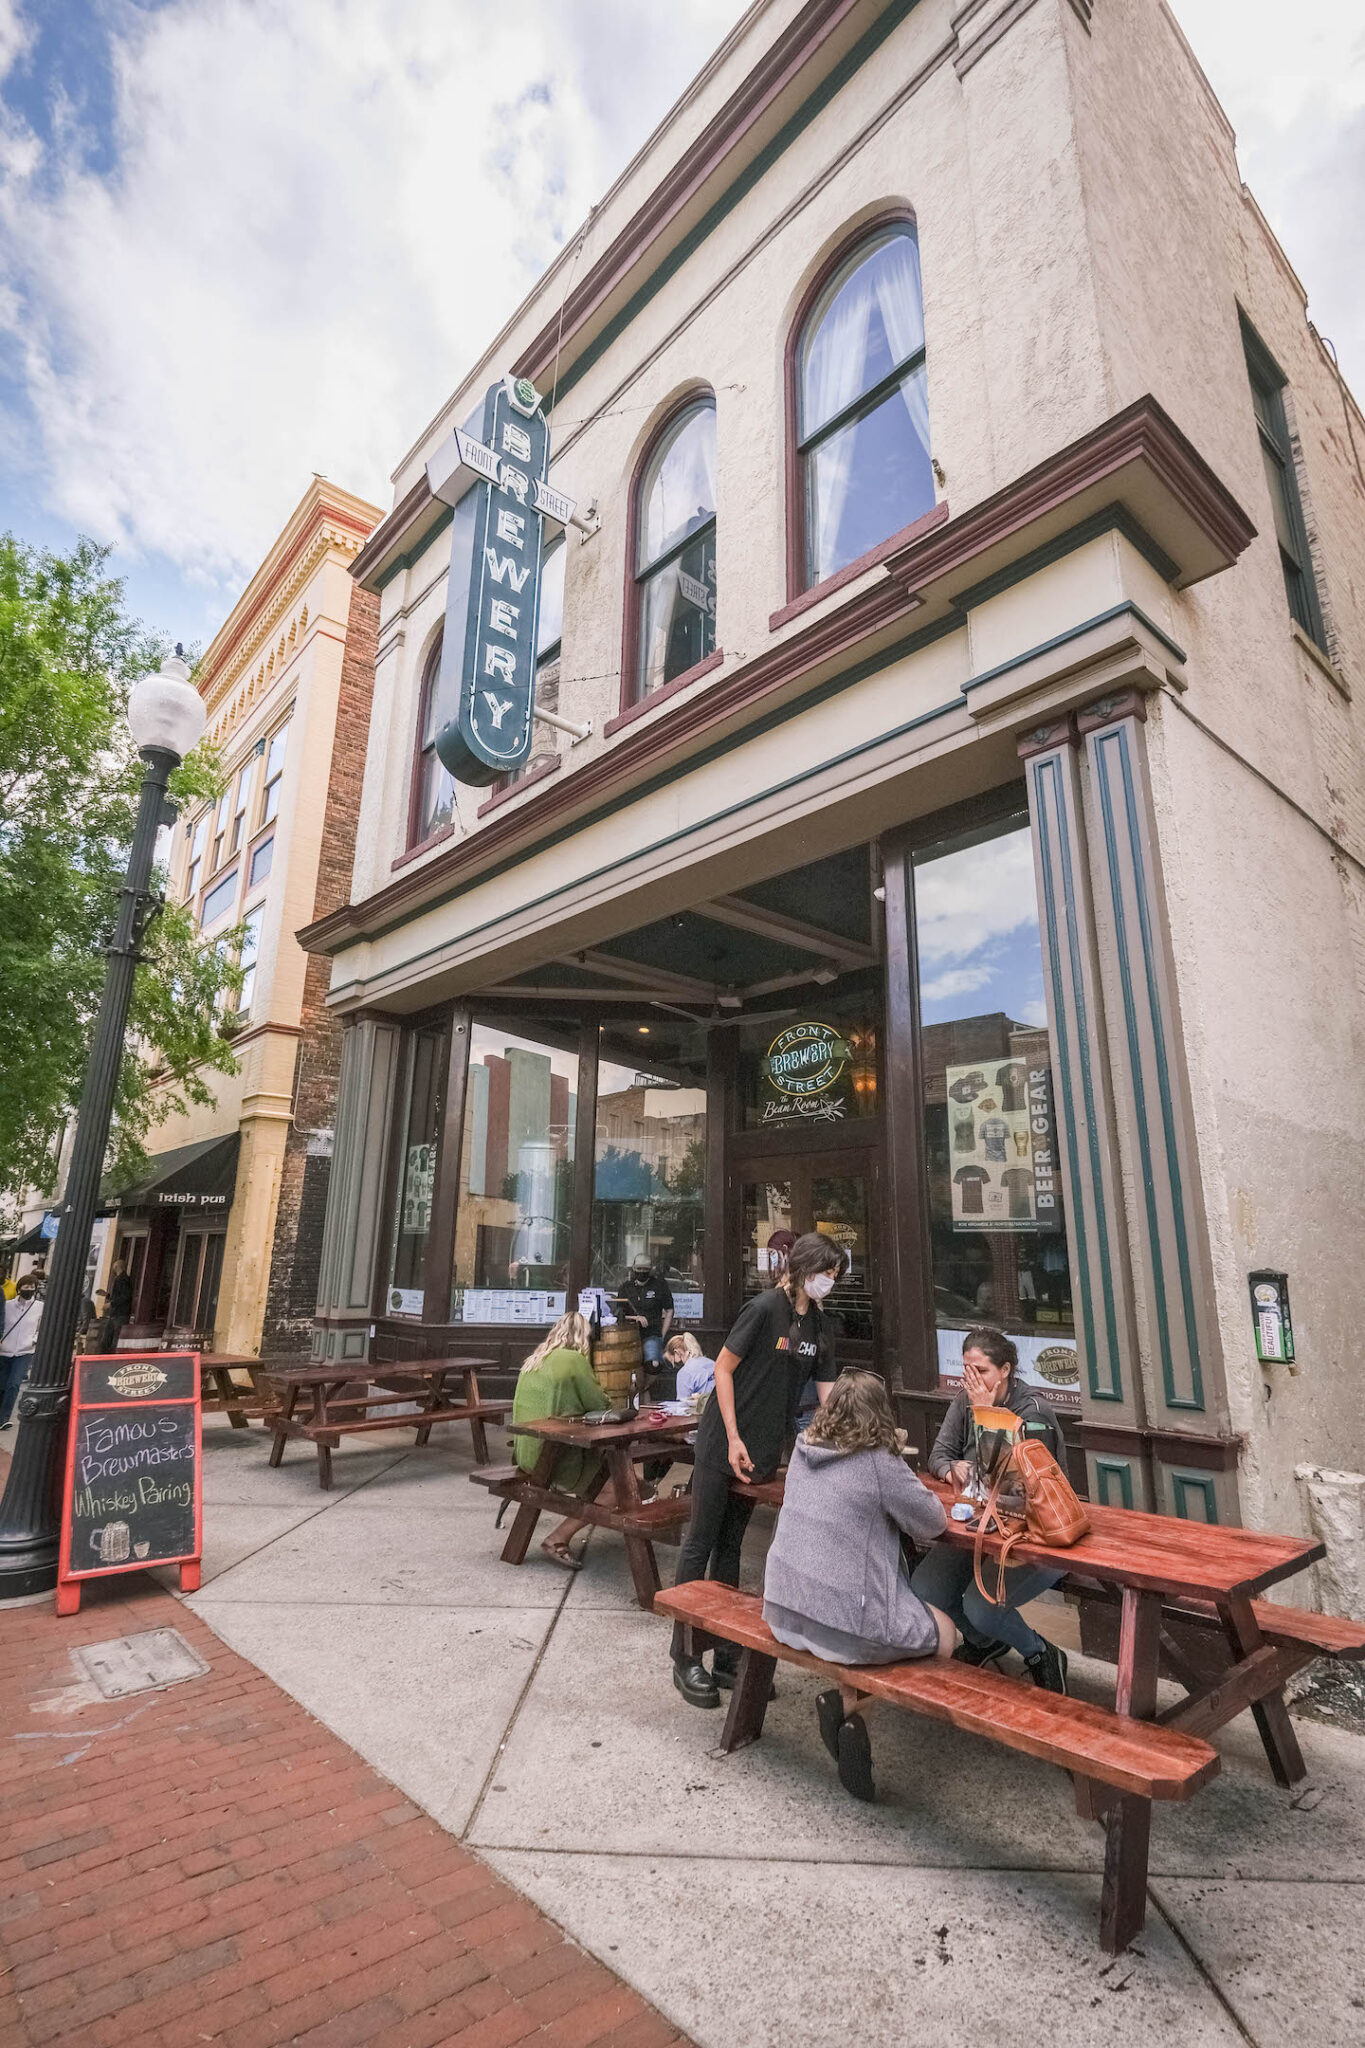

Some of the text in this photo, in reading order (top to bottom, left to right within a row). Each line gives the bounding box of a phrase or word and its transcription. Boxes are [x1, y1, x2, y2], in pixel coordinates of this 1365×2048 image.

[465, 441, 493, 472] FRONT
[540, 488, 569, 519] STREET
[482, 422, 532, 730] BREWERY
[777, 1025, 832, 1049] FRONT
[773, 1040, 834, 1075] BREWERY
[776, 1066, 834, 1092] STREET
[791, 1097, 820, 1113] Room
[1029, 1068, 1055, 1208] BEER GEAR
[1041, 1348, 1078, 1359] FRONT
[116, 1372, 158, 1387] BREWERY
[119, 1364, 156, 1375] FRONT
[118, 1385, 157, 1396] STREET
[75, 1476, 191, 1519] Whiskey Pairing
